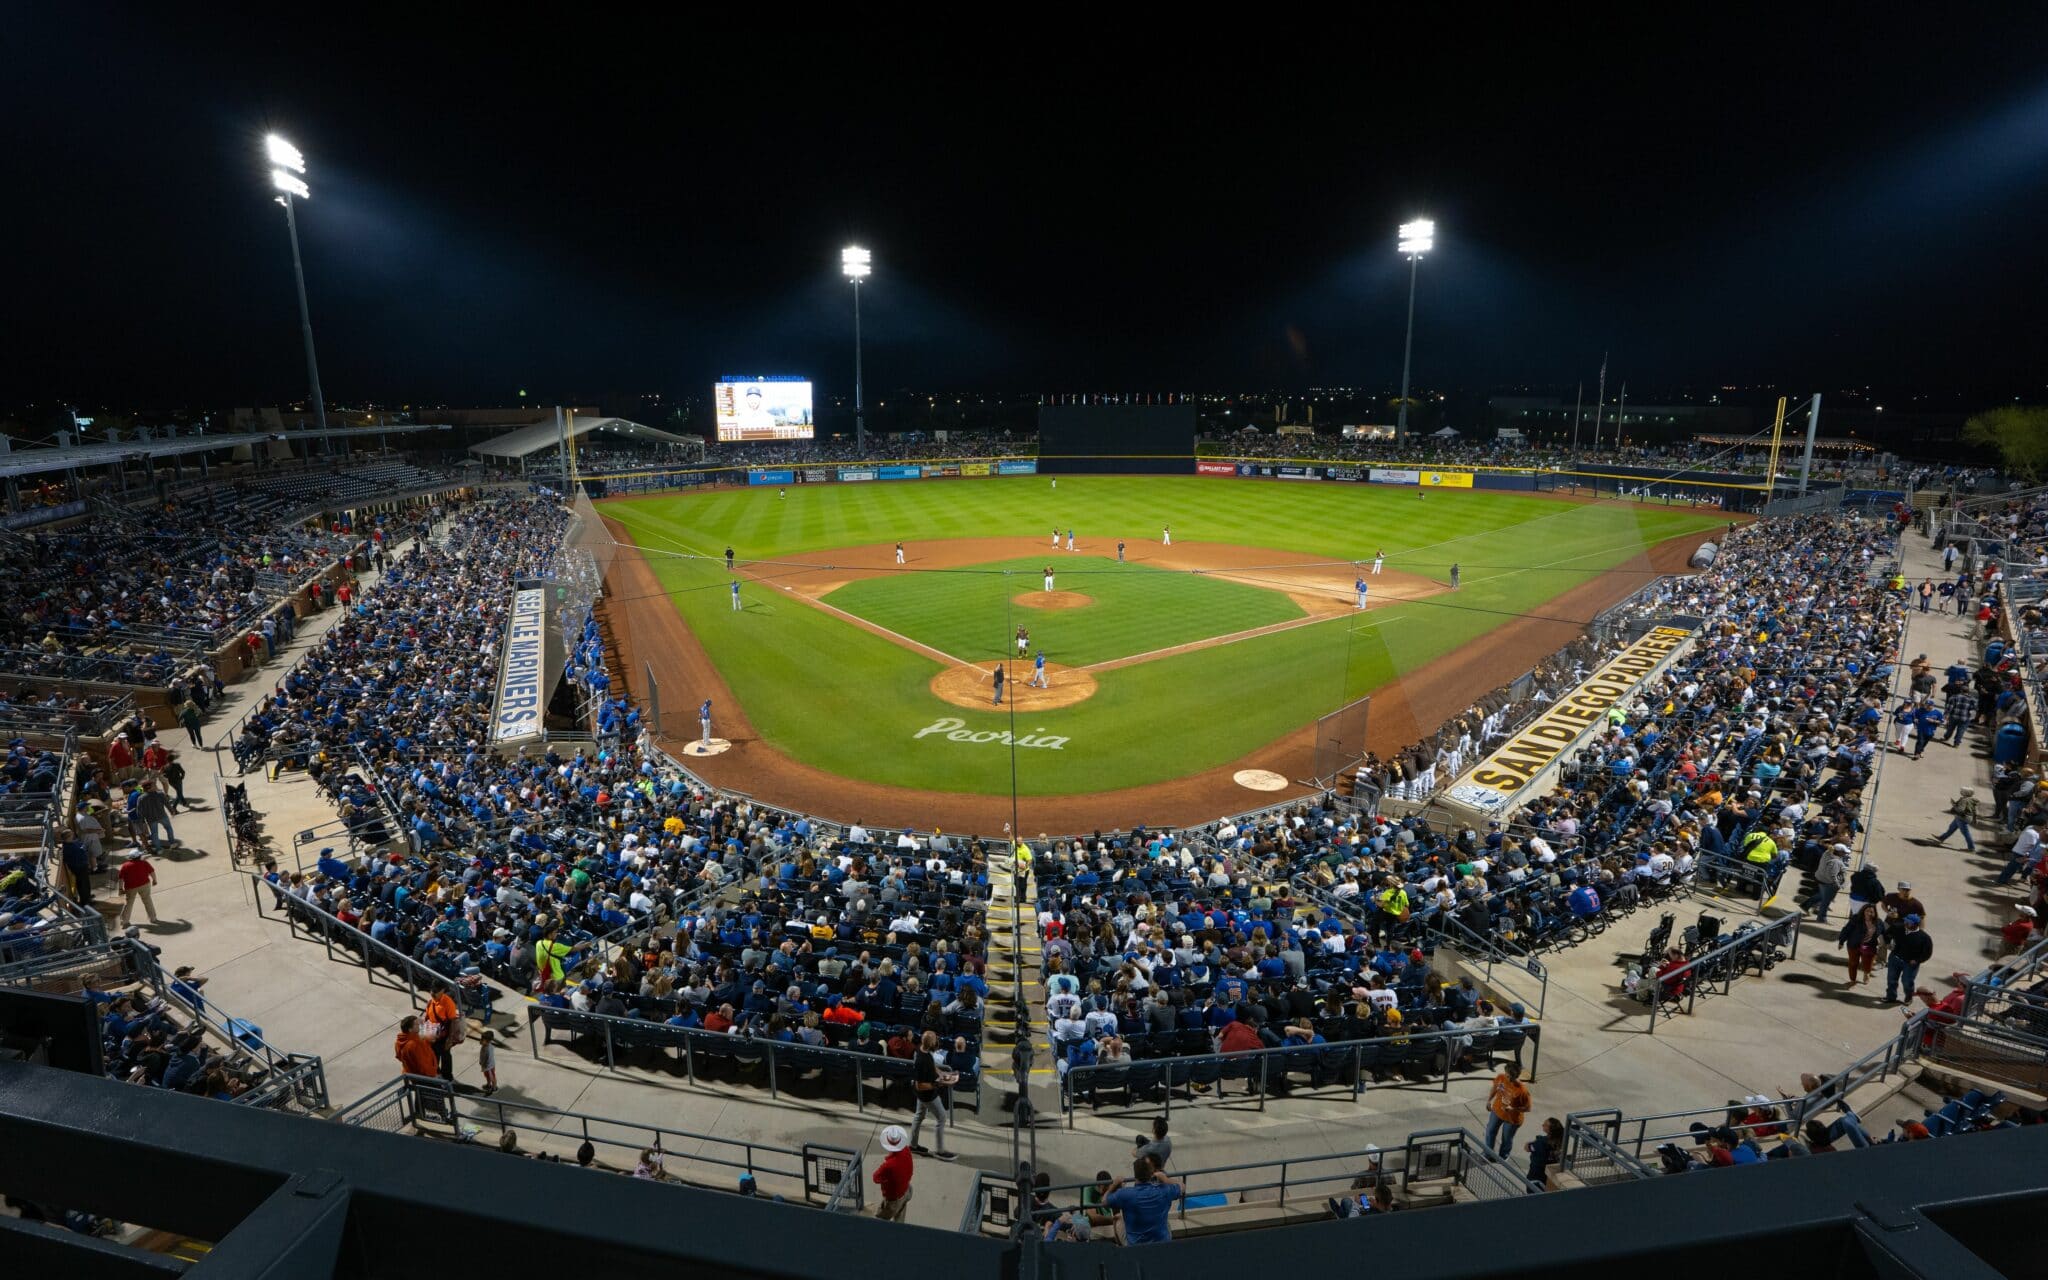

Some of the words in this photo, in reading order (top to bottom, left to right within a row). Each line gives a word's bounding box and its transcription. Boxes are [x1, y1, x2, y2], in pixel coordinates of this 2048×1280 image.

[512, 594, 540, 638] SEATTLE
[499, 640, 539, 724] MARINERS
[912, 716, 1071, 750] Peoria
[1472, 738, 1562, 791] SAN
[1528, 682, 1624, 744] DIEGO
[1597, 631, 1684, 686] PADRES
[1661, 861, 1673, 870] 20
